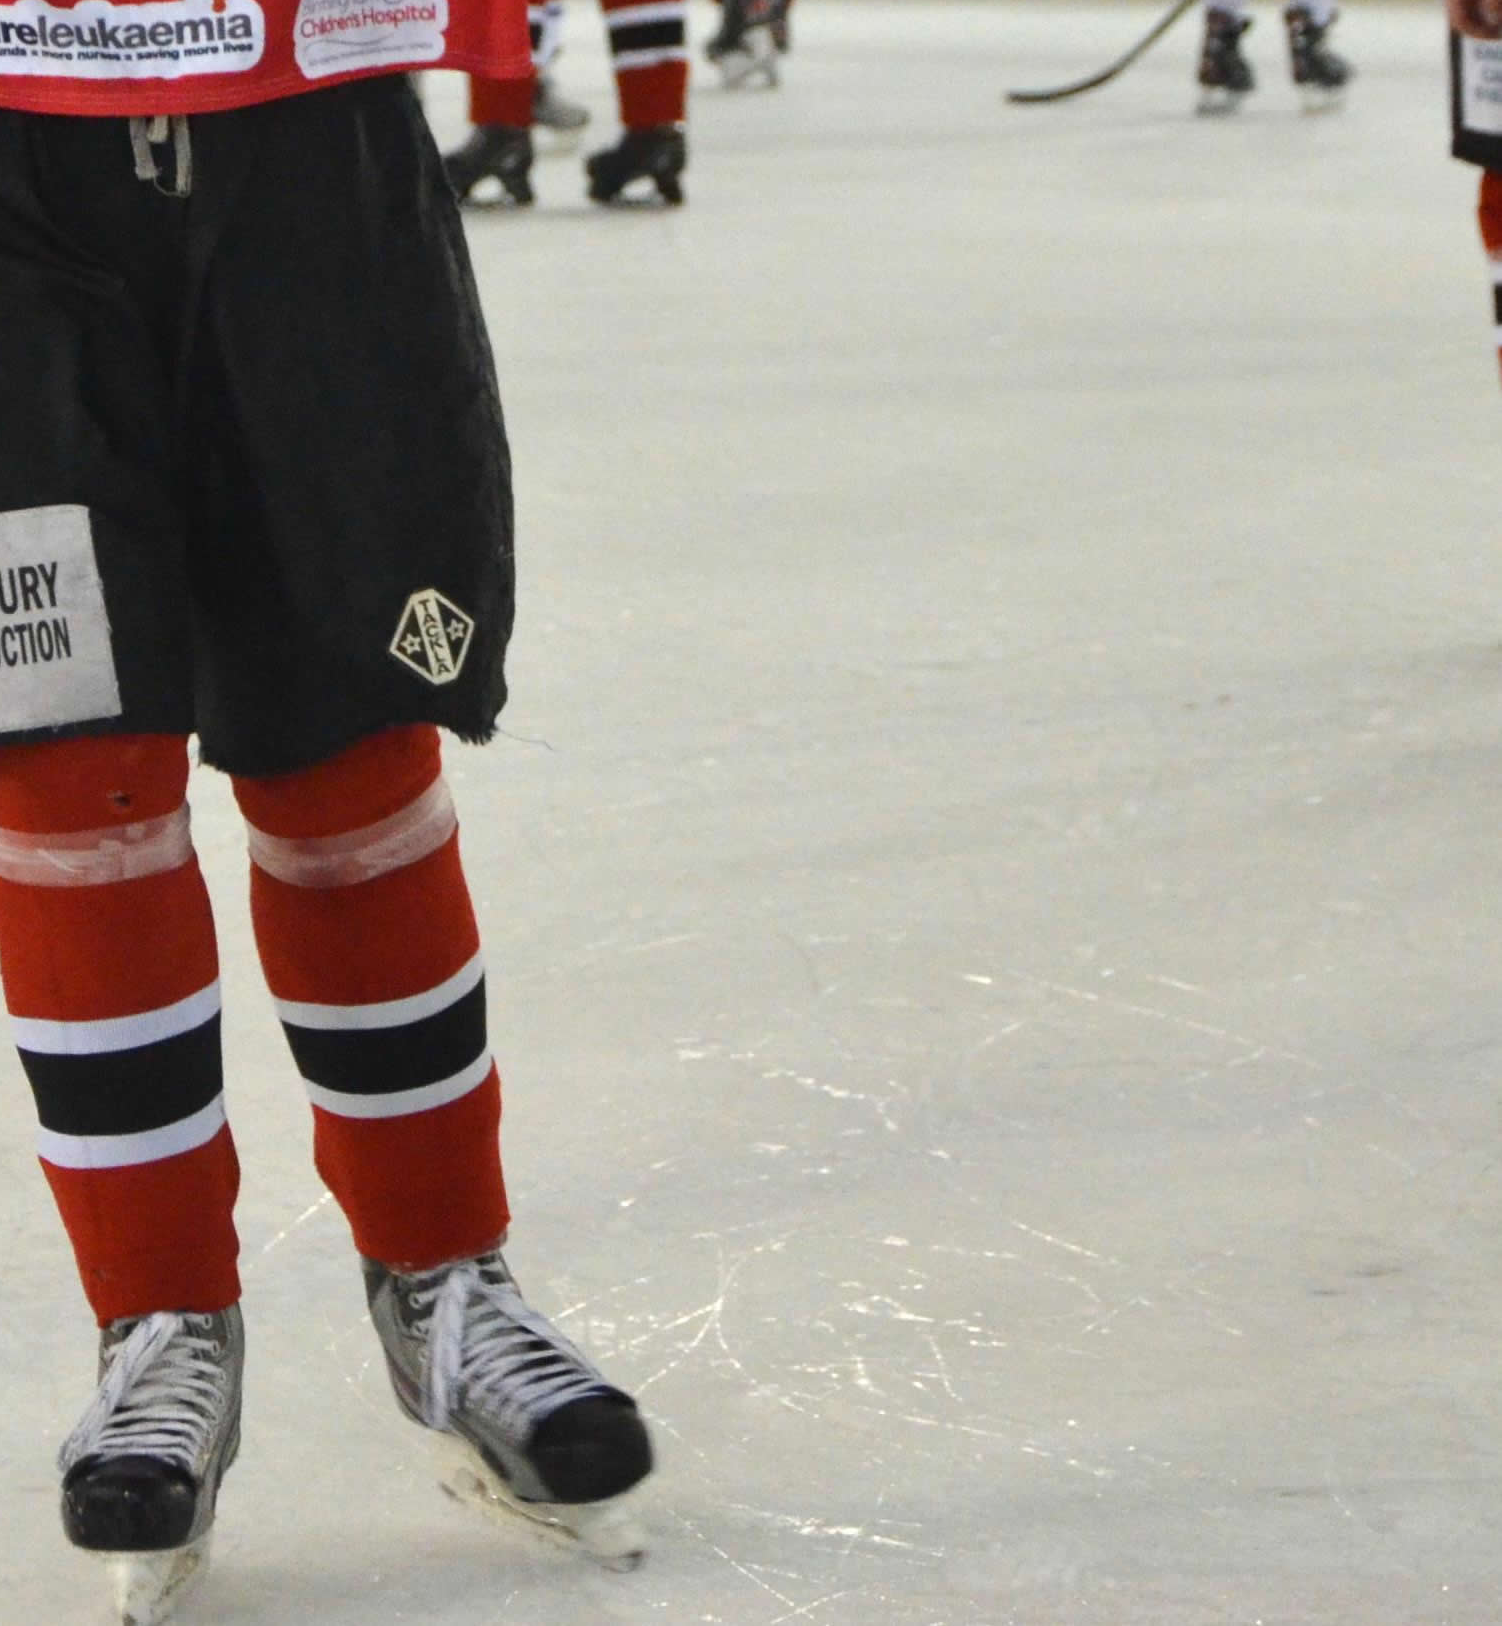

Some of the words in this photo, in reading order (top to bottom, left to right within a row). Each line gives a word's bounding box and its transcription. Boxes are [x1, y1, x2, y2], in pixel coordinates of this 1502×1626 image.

[361, 3, 437, 28] Hospital
[184, 44, 219, 57] more
[222, 42, 254, 55] lives
[417, 598, 452, 677] TACKLA
